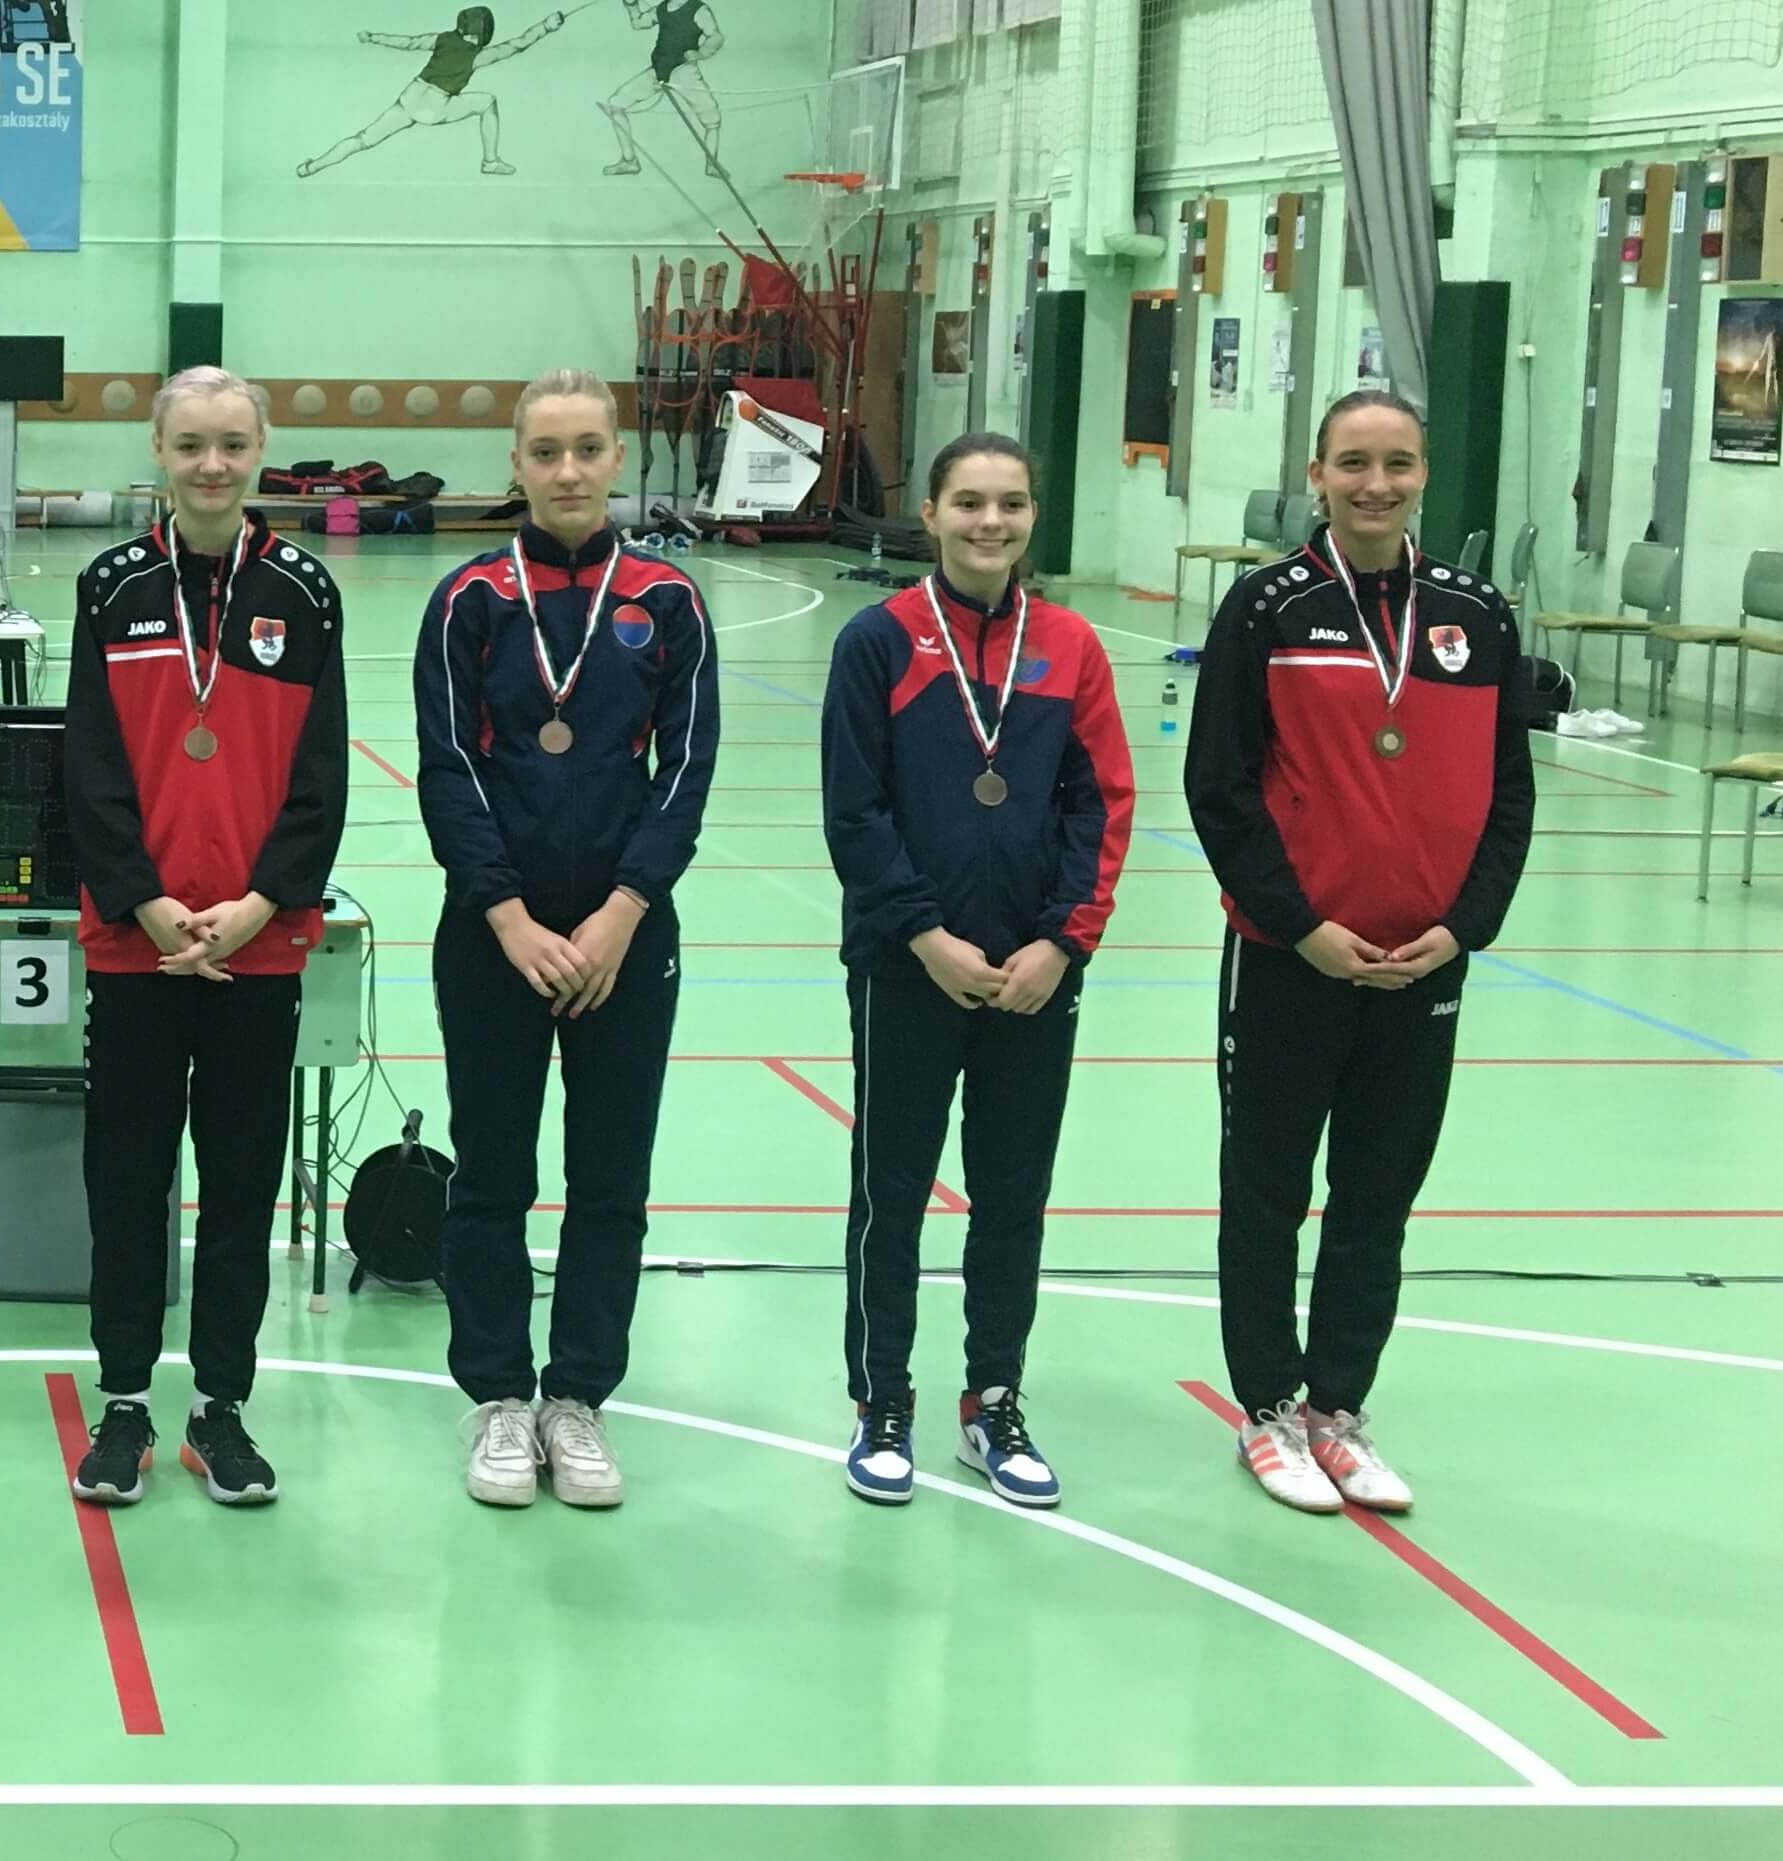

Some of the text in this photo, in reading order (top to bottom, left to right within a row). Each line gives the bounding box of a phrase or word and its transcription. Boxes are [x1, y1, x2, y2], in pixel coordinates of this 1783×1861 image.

[16, 41, 72, 105] SE
[127, 620, 167, 636] JAKO
[1309, 627, 1349, 642] JAKO
[15, 956, 49, 1008] 3
